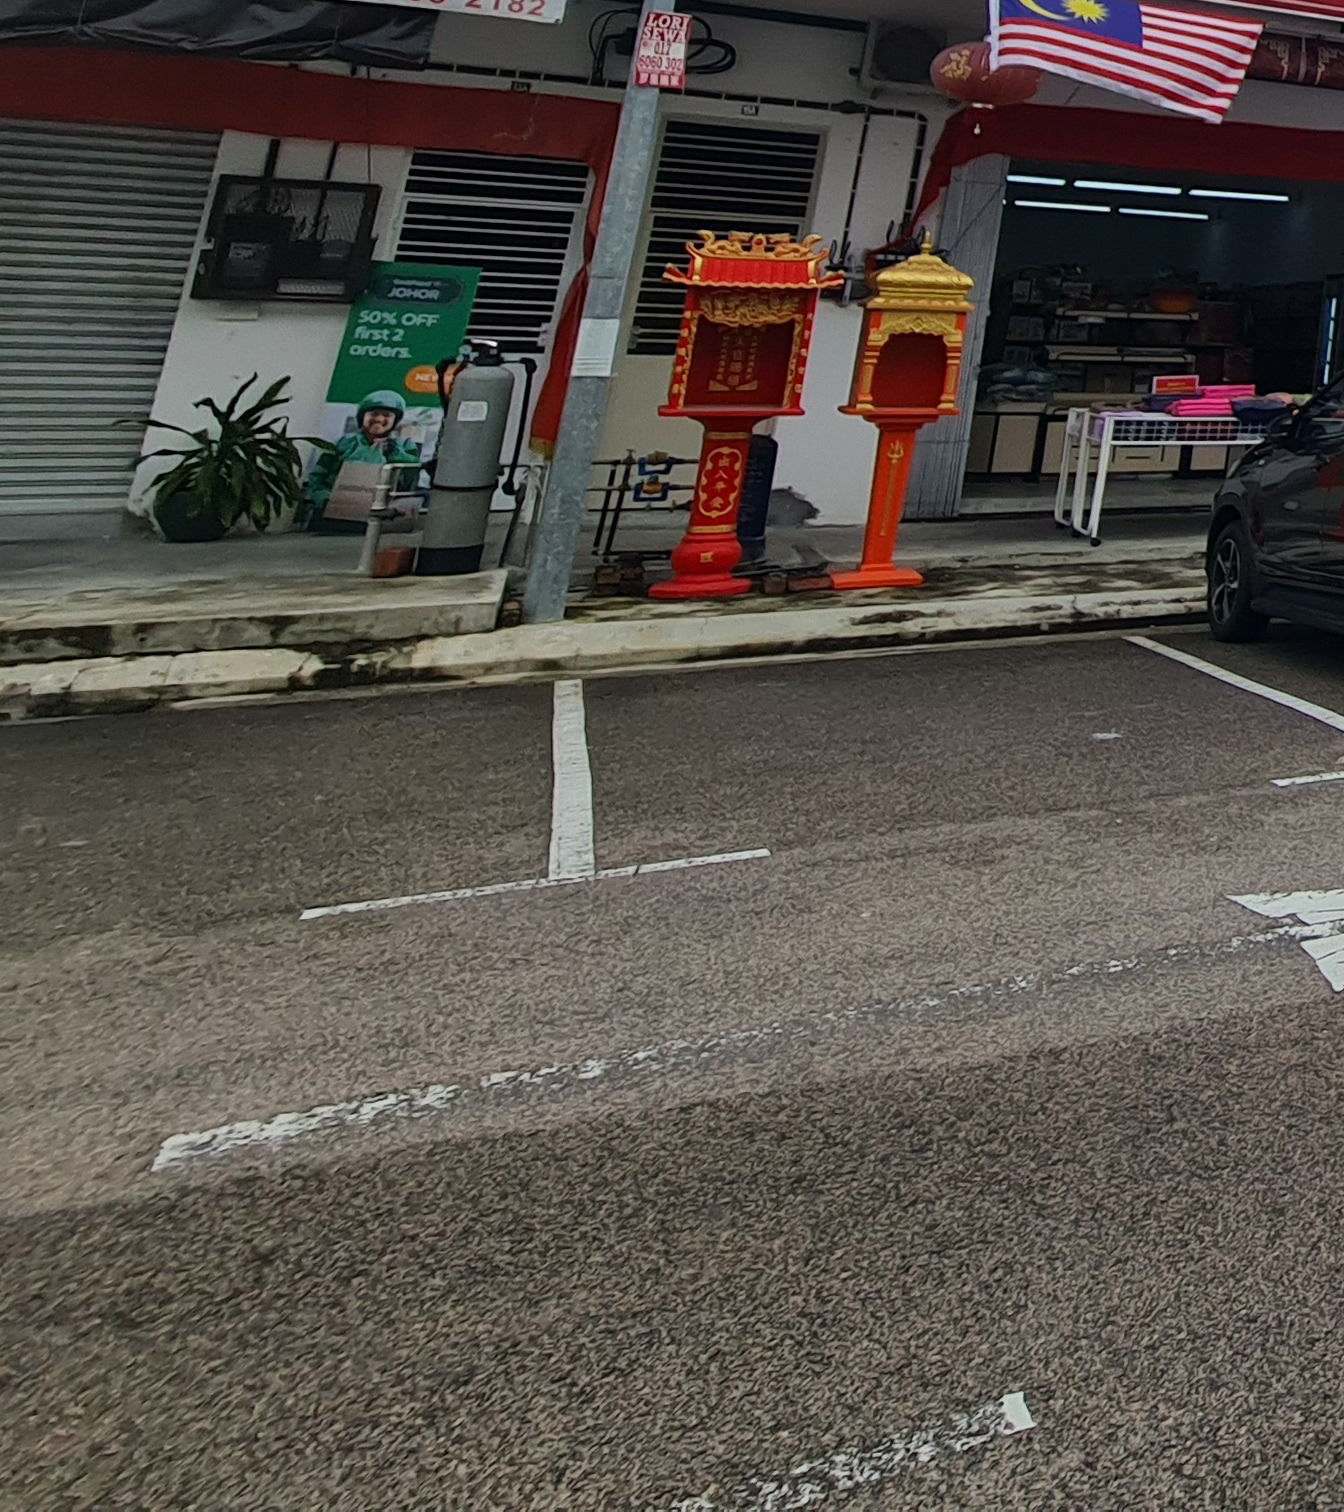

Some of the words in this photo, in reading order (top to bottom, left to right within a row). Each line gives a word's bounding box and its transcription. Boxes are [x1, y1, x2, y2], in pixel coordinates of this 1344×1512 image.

[646, 14, 690, 29] LORI
[642, 27, 687, 43] SEWA
[387, 287, 440, 301] JOHOR
[358, 310, 399, 326] 50%
[401, 312, 440, 327] OFF
[353, 326, 391, 342] first
[391, 329, 405, 342] 2
[349, 343, 412, 359] orders.
